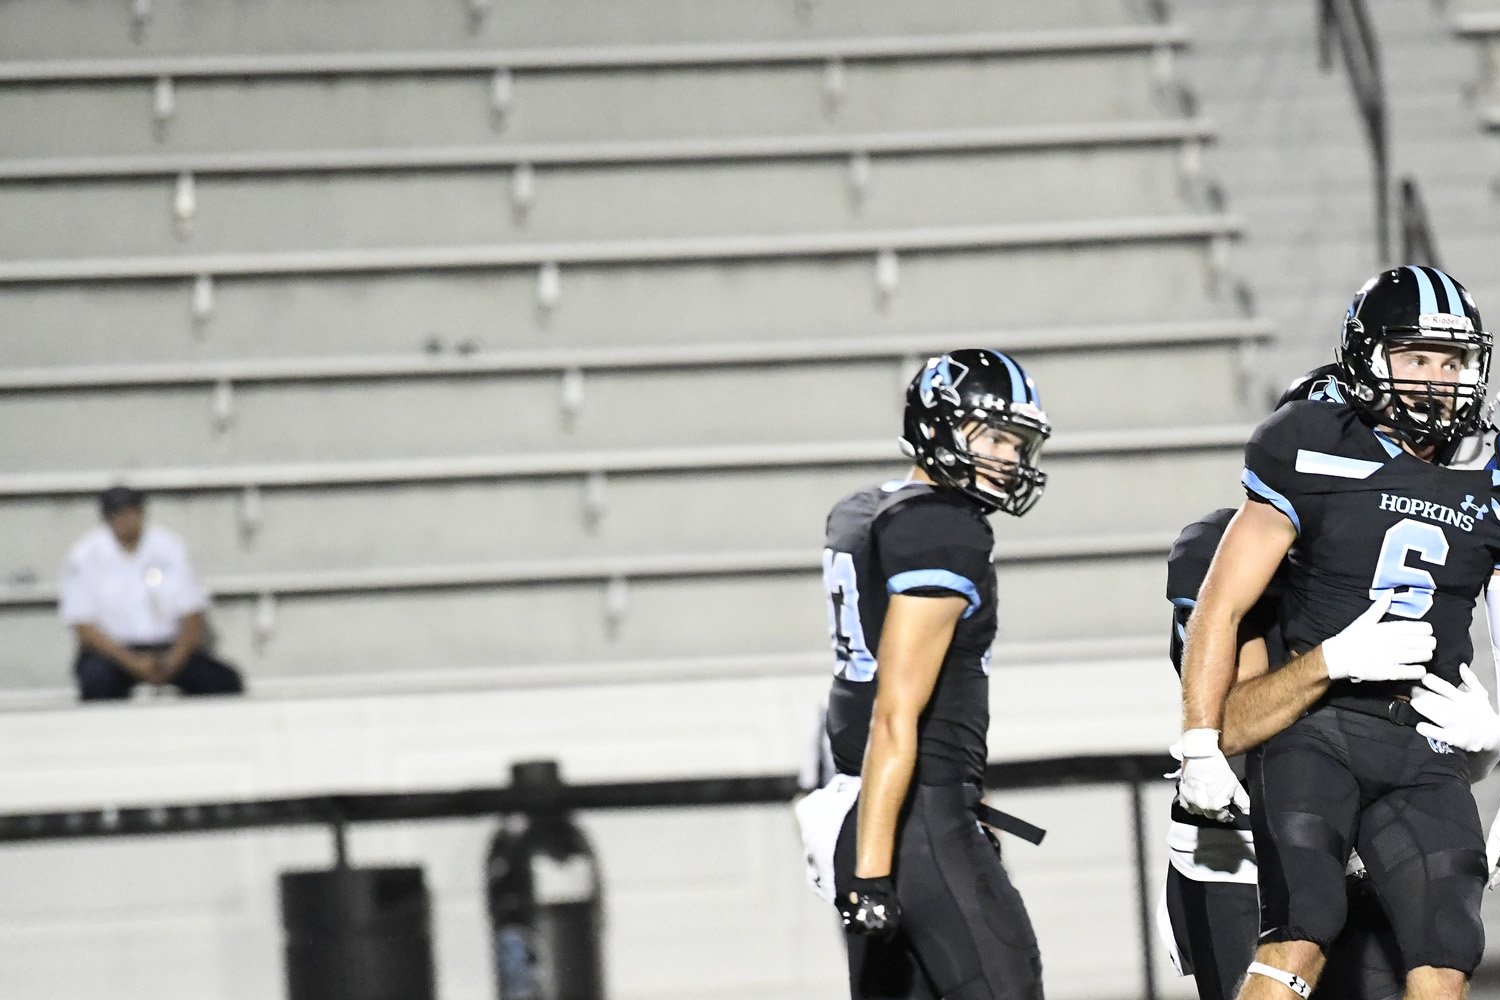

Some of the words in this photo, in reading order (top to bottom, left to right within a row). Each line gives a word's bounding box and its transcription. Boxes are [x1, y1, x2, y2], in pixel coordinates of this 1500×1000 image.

[1432, 316, 1459, 325] Riddell
[1379, 493, 1475, 532] HOPKINS
[1370, 518, 1450, 620] 6
